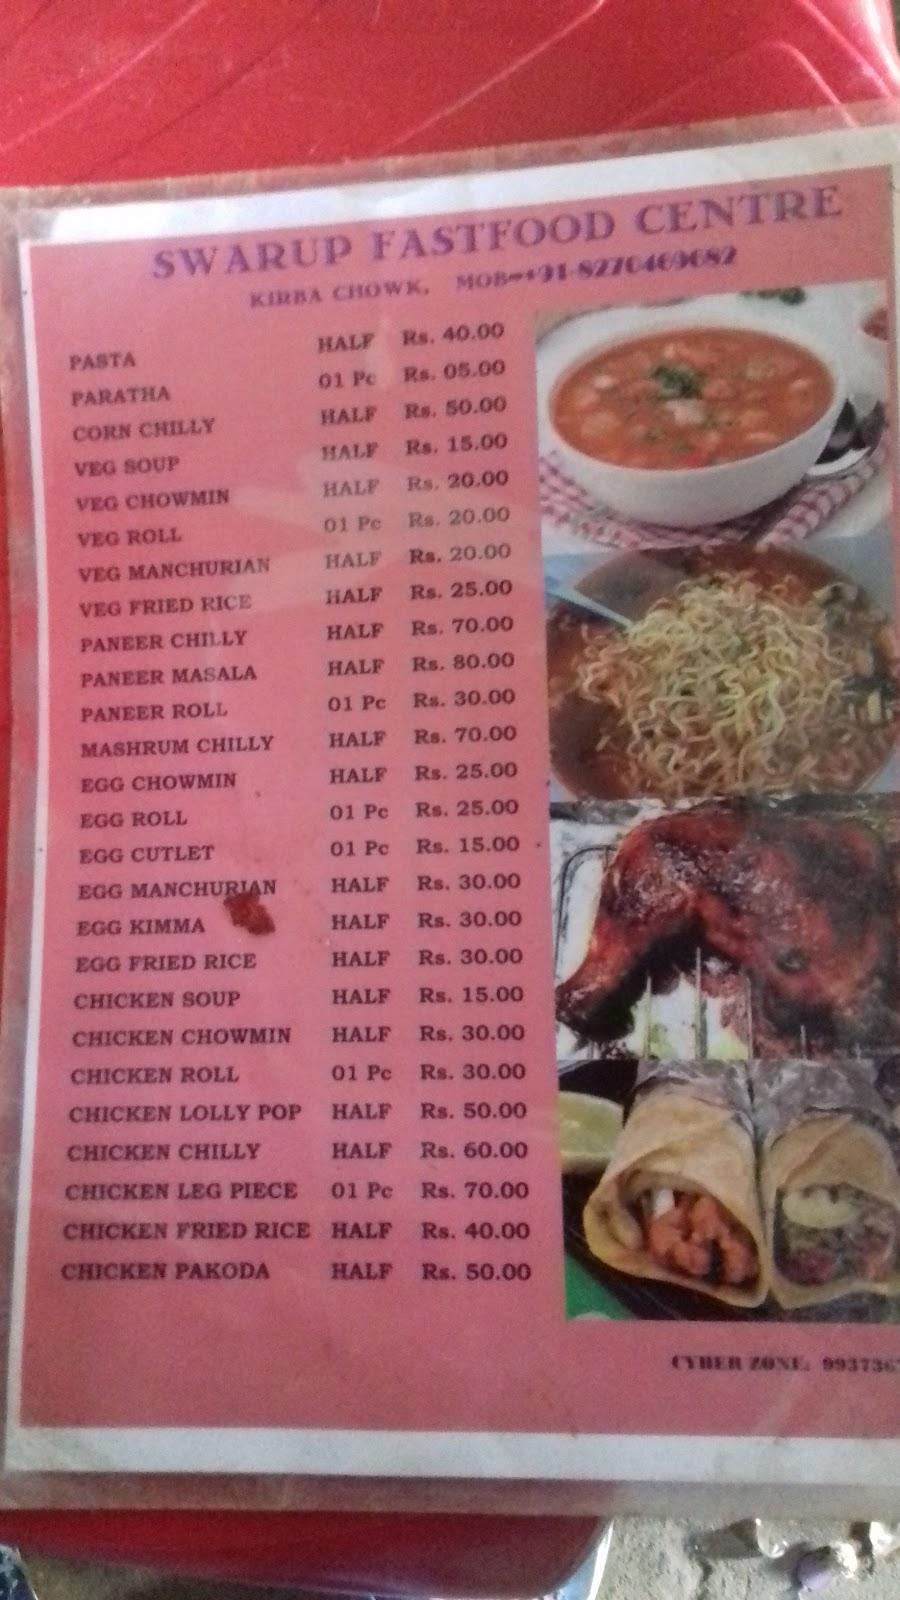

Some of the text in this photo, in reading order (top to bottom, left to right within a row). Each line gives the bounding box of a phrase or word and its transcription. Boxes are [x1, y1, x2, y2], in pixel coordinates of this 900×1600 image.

[152, 184, 843, 280] SWARUP FASTFOOD CENTRE
[250, 287, 323, 309] KIRBA
[69, 321, 505, 371] PASTA HALF Rs. 40.00
[71, 359, 506, 408] PARATHA 01 Pc Rs. 05.00
[72, 395, 507, 443] CORN CHILLY HALF Rs. 50.00
[74, 432, 508, 477] VEG SOUP HALF Rs. 15.00
[75, 469, 509, 512] VEG CHOWMIN HALF Rs. 20.00
[77, 506, 510, 548] VEG ROLL 01 Pc Rs. 20.00
[78, 542, 511, 583] VEG MANCHURIAN HALF Rs. 20.00
[79, 579, 513, 618] VEG FRIED RICE HALF Rs. 25.00
[80, 615, 514, 654] PANEER CHILLY HALF Rs. 70.00
[80, 651, 515, 689] PANEER MASALA HALF Rs. 80.00
[81, 688, 516, 723] PANEER ROLL 01 Pc Rs. 30.00
[80, 724, 517, 759] MASHRUM CHILLY HALF Rs. 70.00
[80, 761, 518, 794] EGG CHOWMIN HALF Rs. 25.00
[80, 798, 519, 830] EGG ROLL 01 Pc Rs. 25.00
[79, 835, 520, 865] EGG CUTLET 01 Pc Rs. 15.00
[77, 872, 521, 901] EGG MANCHURIAN HALF Rs. 30.00
[76, 910, 523, 937] EGG KIMMA HALF Rs. 30.00
[75, 947, 523, 974] EGG FRIED RICE HALF Rs. 30.00
[73, 985, 524, 1010] CHICKEN SOUP HALF Rs. 15.00
[71, 1024, 526, 1048] CHICKEN CHOWMIN HALF Rs. 30.00
[70, 1062, 526, 1086] CHICKEN ROLL 01 Pc Rs. 30.00
[68, 1101, 527, 1124] CHICKEN LOLLY POP HALF Rs. 50.00
[66, 1141, 529, 1162] CHICKEN CHILLY HALF Rs. 60.00
[65, 1180, 530, 1201] CHICKEN LEG PIECE 01 Pc Rs. 70.00
[62, 1221, 531, 1241] CHICKEN FRIED RICE HALF Rs. 40.00
[60, 1261, 532, 1282] CHICKEN PAKODA HALF Rs. 50.00
[671, 1355, 742, 1371] CYBER
